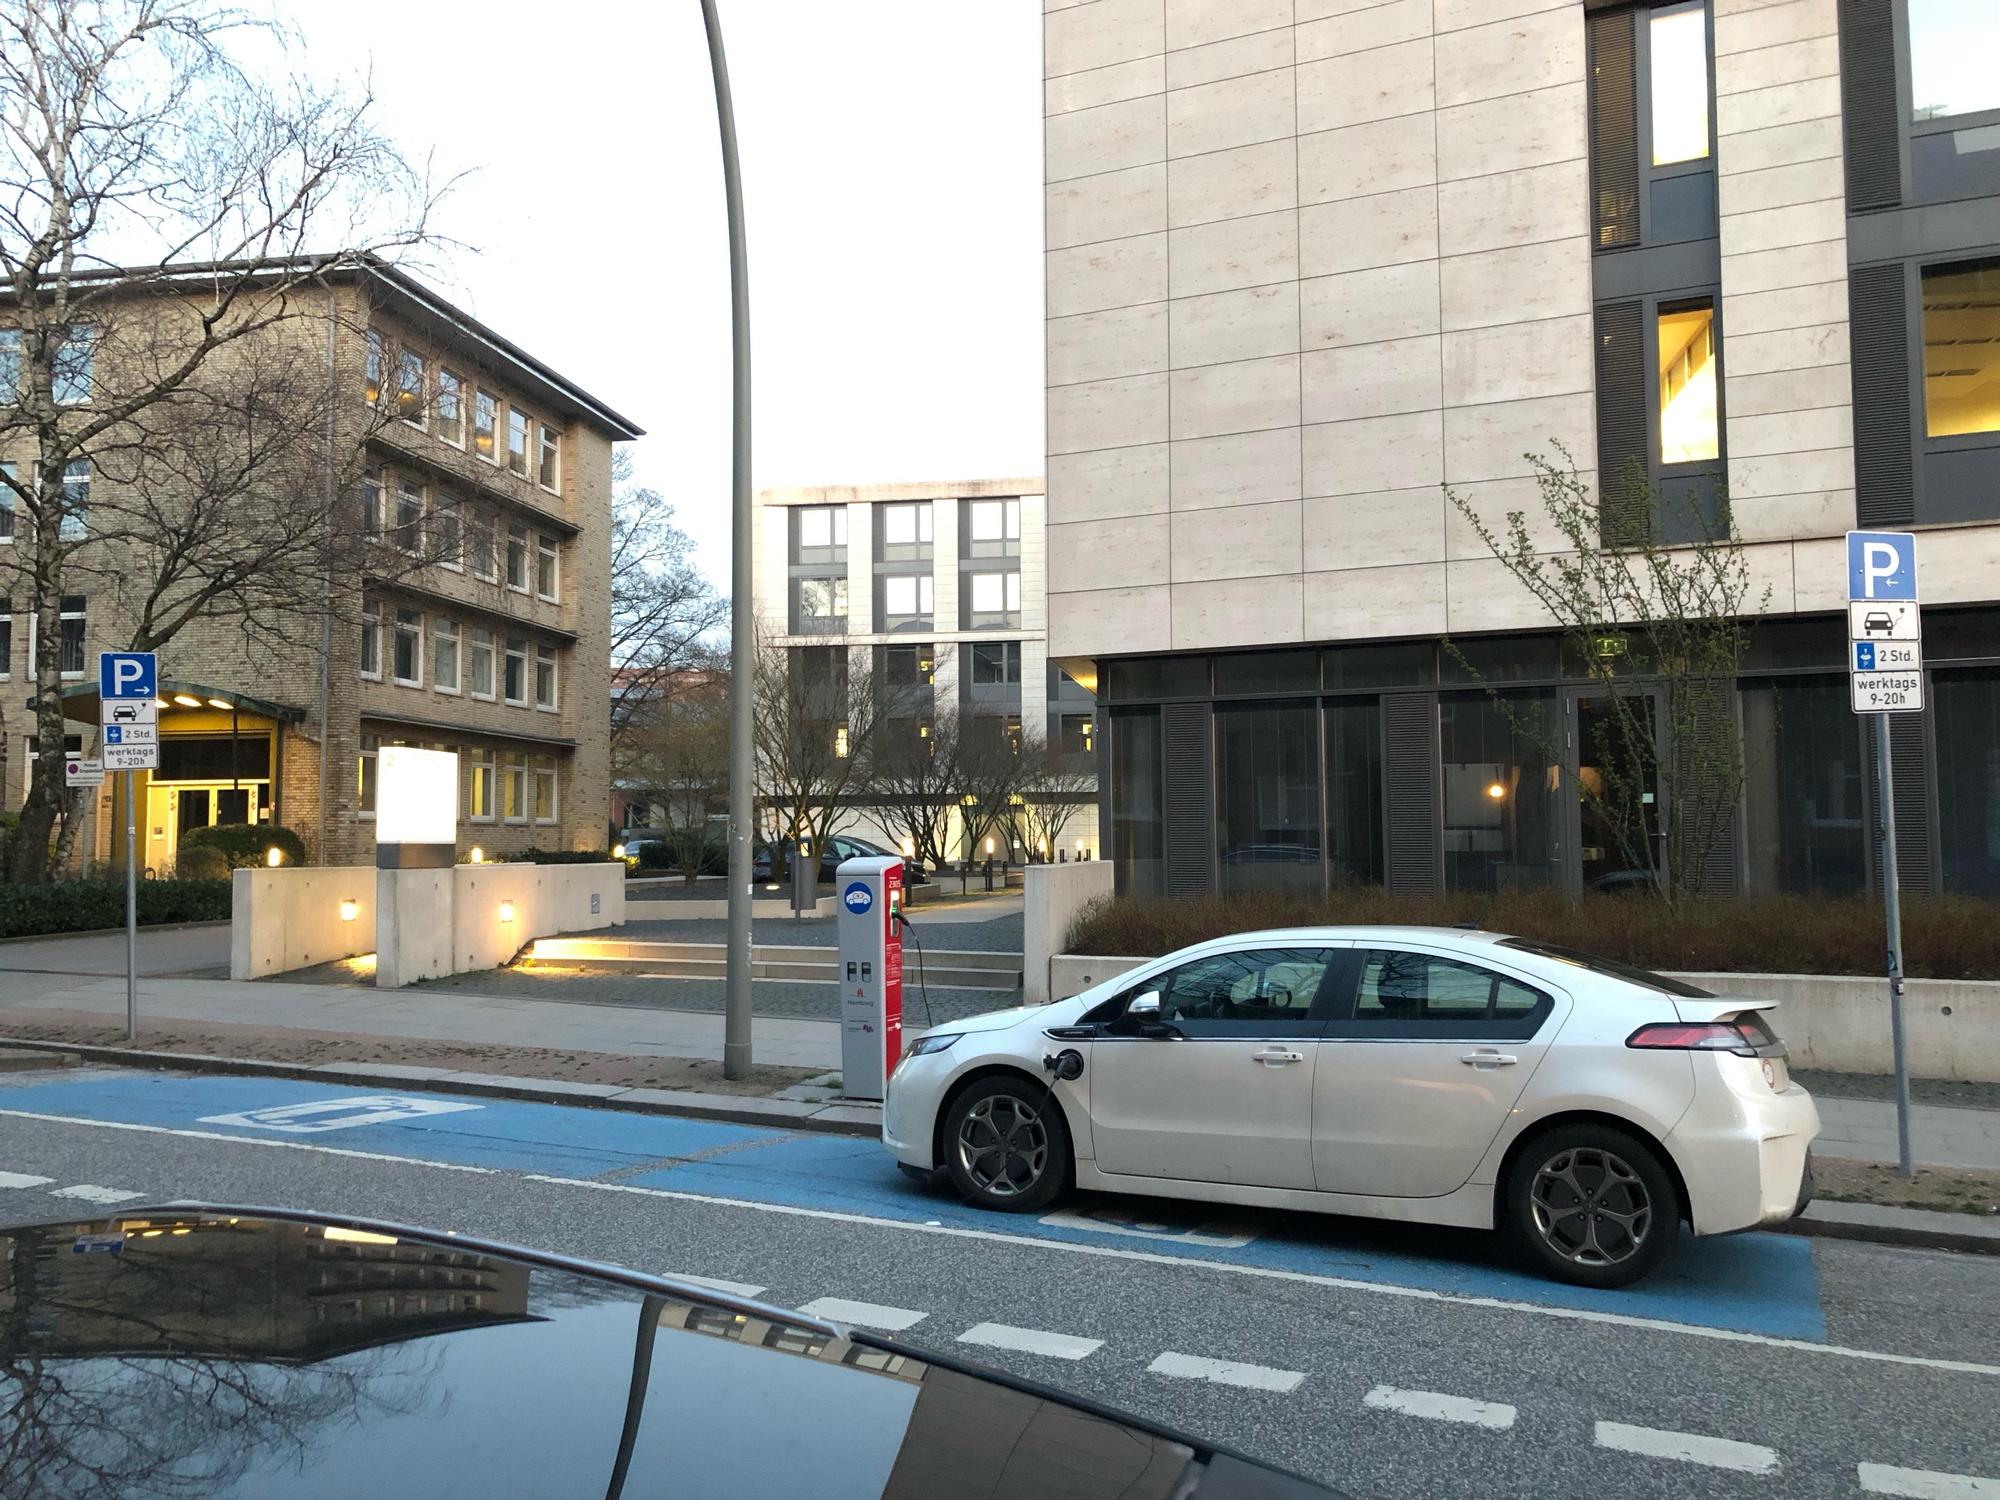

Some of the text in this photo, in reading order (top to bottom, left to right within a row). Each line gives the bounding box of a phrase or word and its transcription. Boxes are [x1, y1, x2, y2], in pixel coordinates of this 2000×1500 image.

[1864, 542, 1900, 598] P
[1880, 650, 1914, 662] 2 Std.
[114, 659, 144, 696] P
[1858, 677, 1917, 693] werktags
[1870, 692, 1906, 705] 9-20h
[125, 730, 152, 739] 2 Std.
[107, 747, 154, 757] werktags
[116, 757, 145, 766] 9-20h
